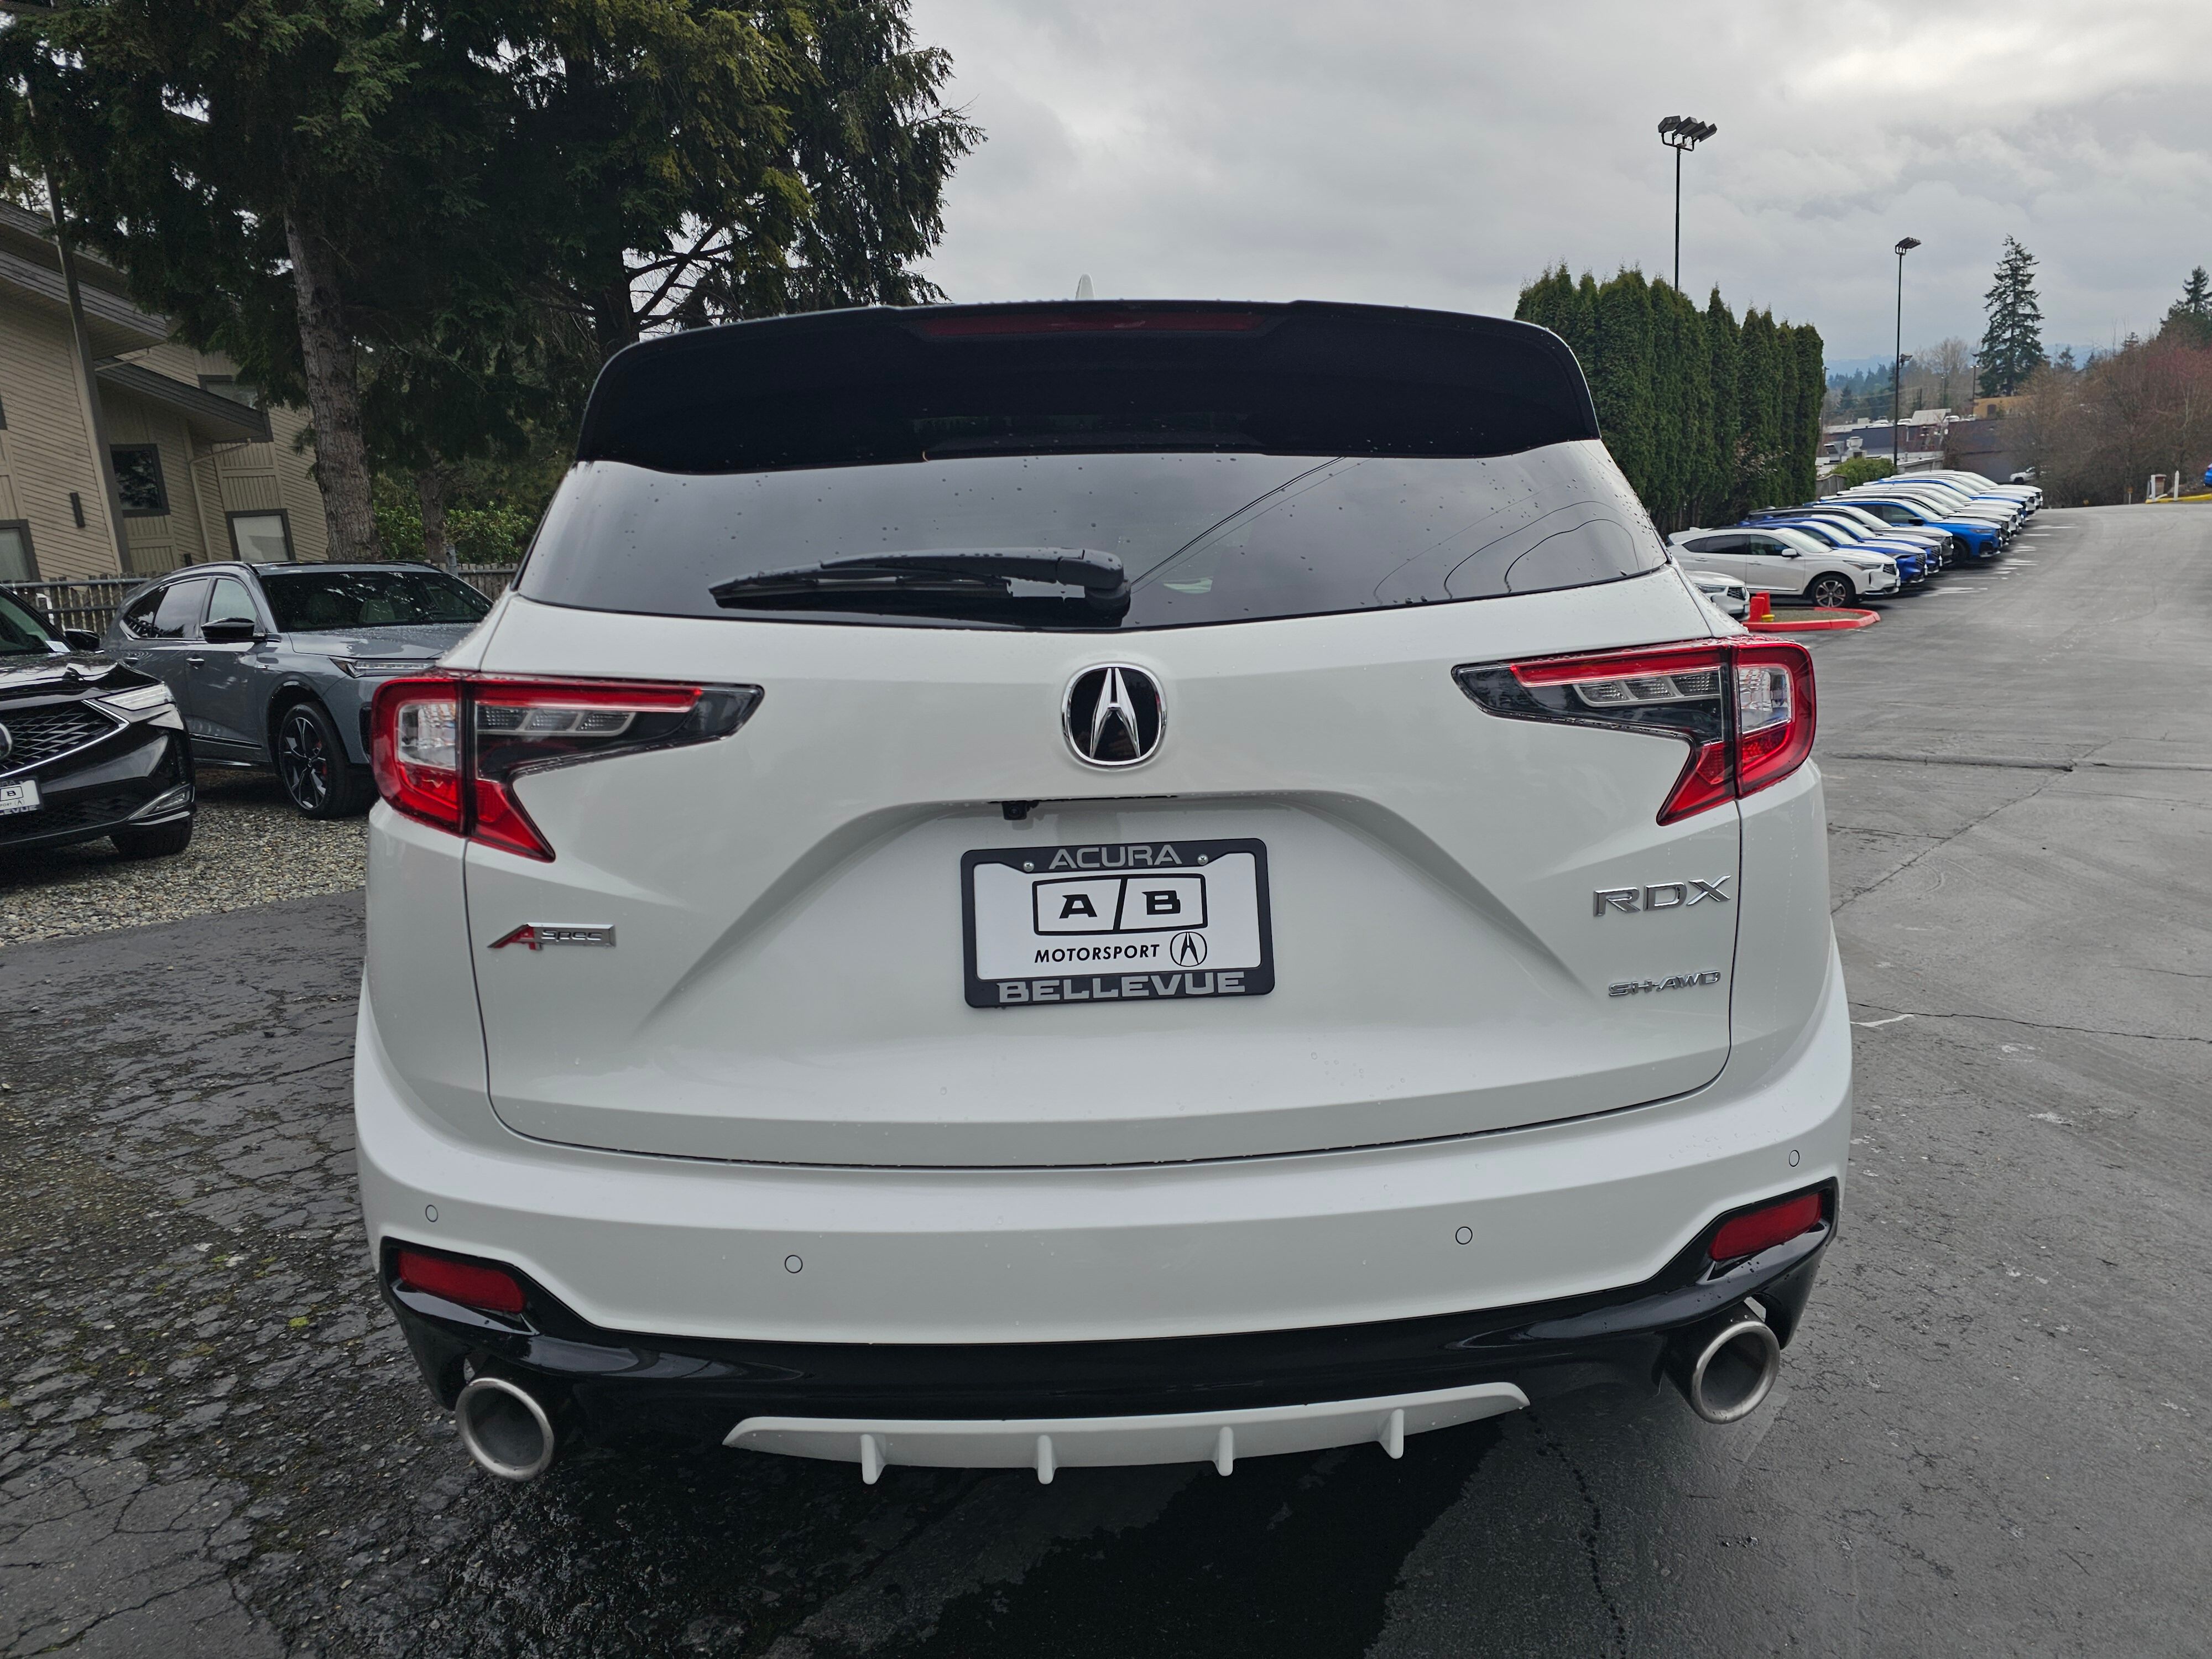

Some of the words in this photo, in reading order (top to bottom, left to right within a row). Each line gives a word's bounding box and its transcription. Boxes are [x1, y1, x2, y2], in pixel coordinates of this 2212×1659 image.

[1048, 844, 1182, 870] ACURA
[1593, 874, 1731, 917] RDX
[1034, 944, 1160, 963] MOTORSPORT
[996, 972, 1245, 1003] BELLEVUE
[1608, 970, 1721, 997] SH-AWD
